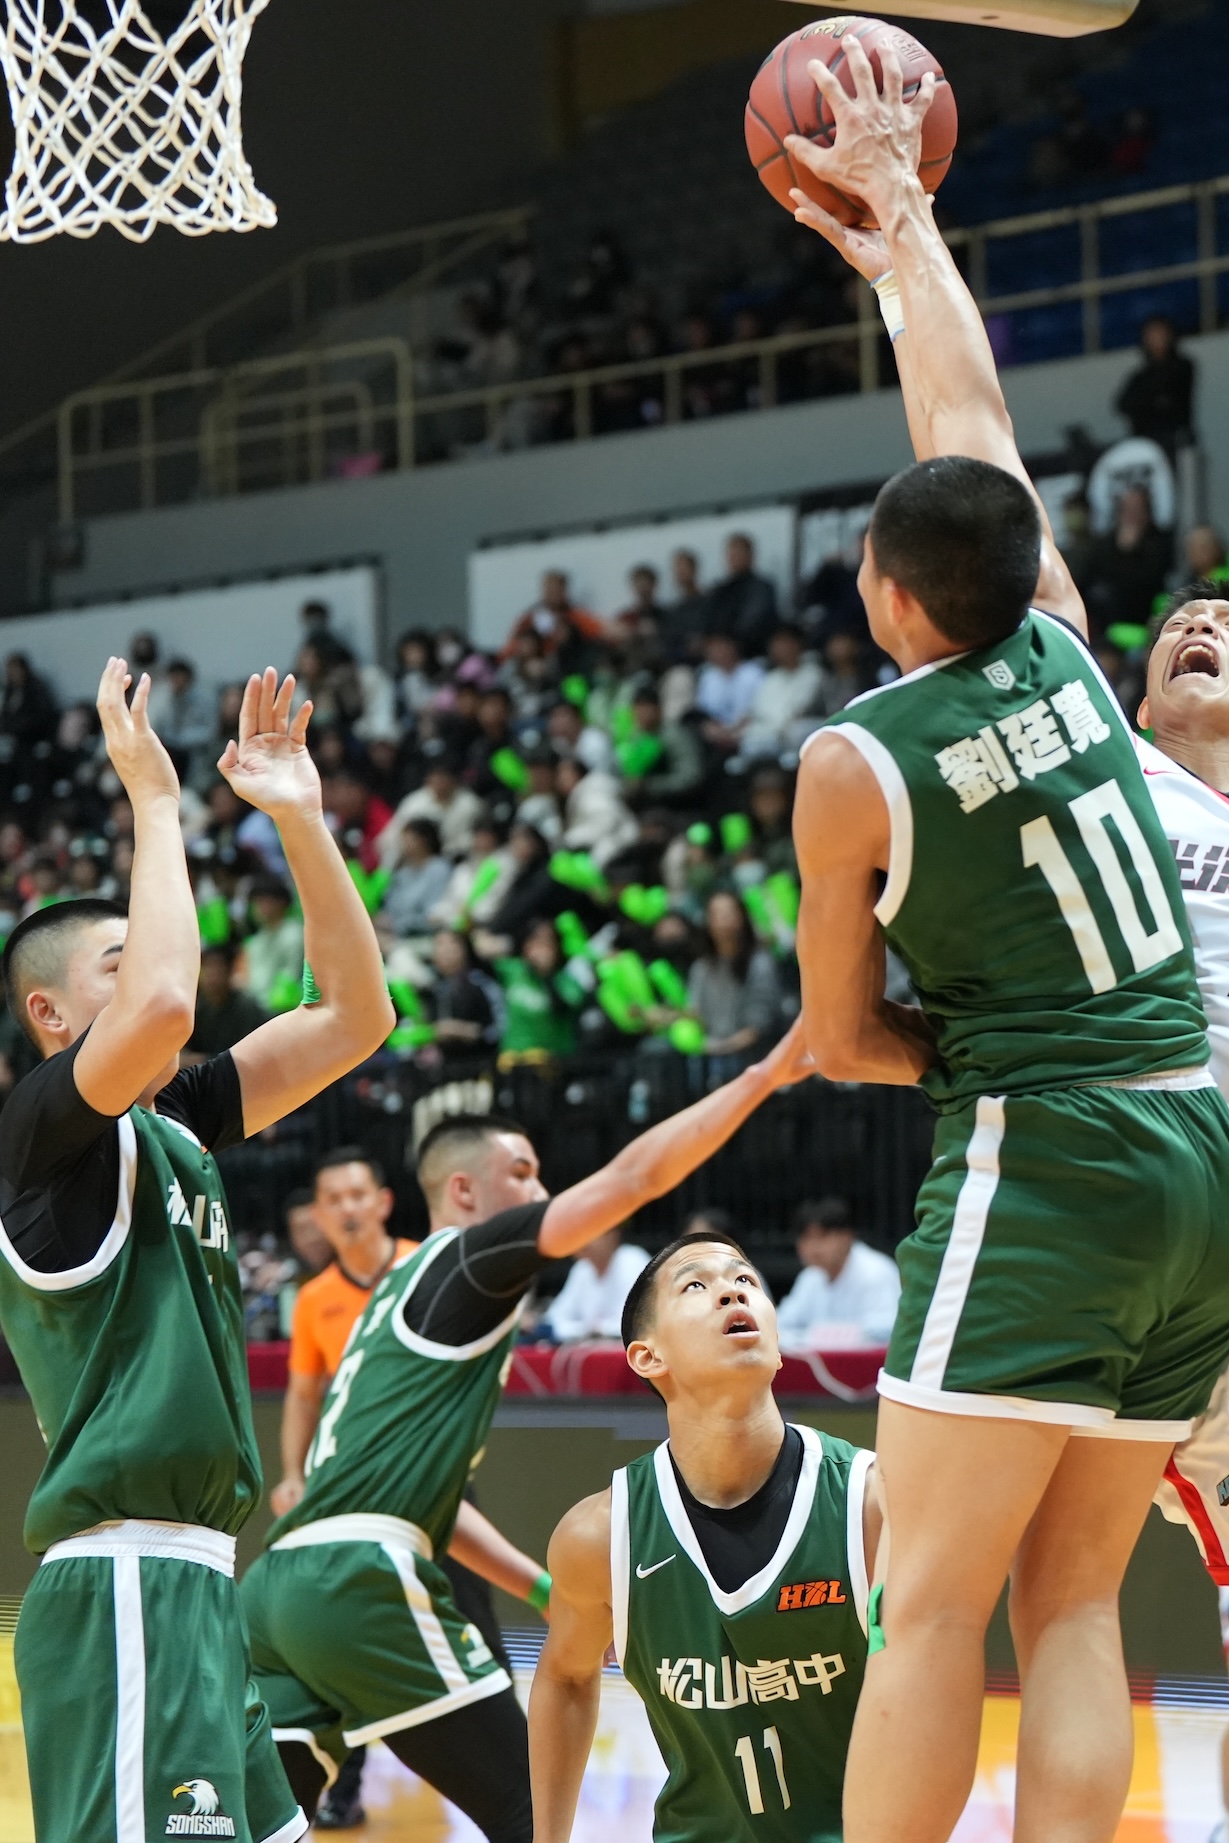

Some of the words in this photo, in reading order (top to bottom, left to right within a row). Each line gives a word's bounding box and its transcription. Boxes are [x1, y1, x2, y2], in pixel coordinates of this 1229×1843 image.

[1020, 778, 1184, 994] 10
[777, 1580, 847, 1611] HBL
[656, 1653, 846, 1709] 松山高中
[735, 1725, 791, 1815] 11
[165, 1814, 236, 1837] SONGSHAN
